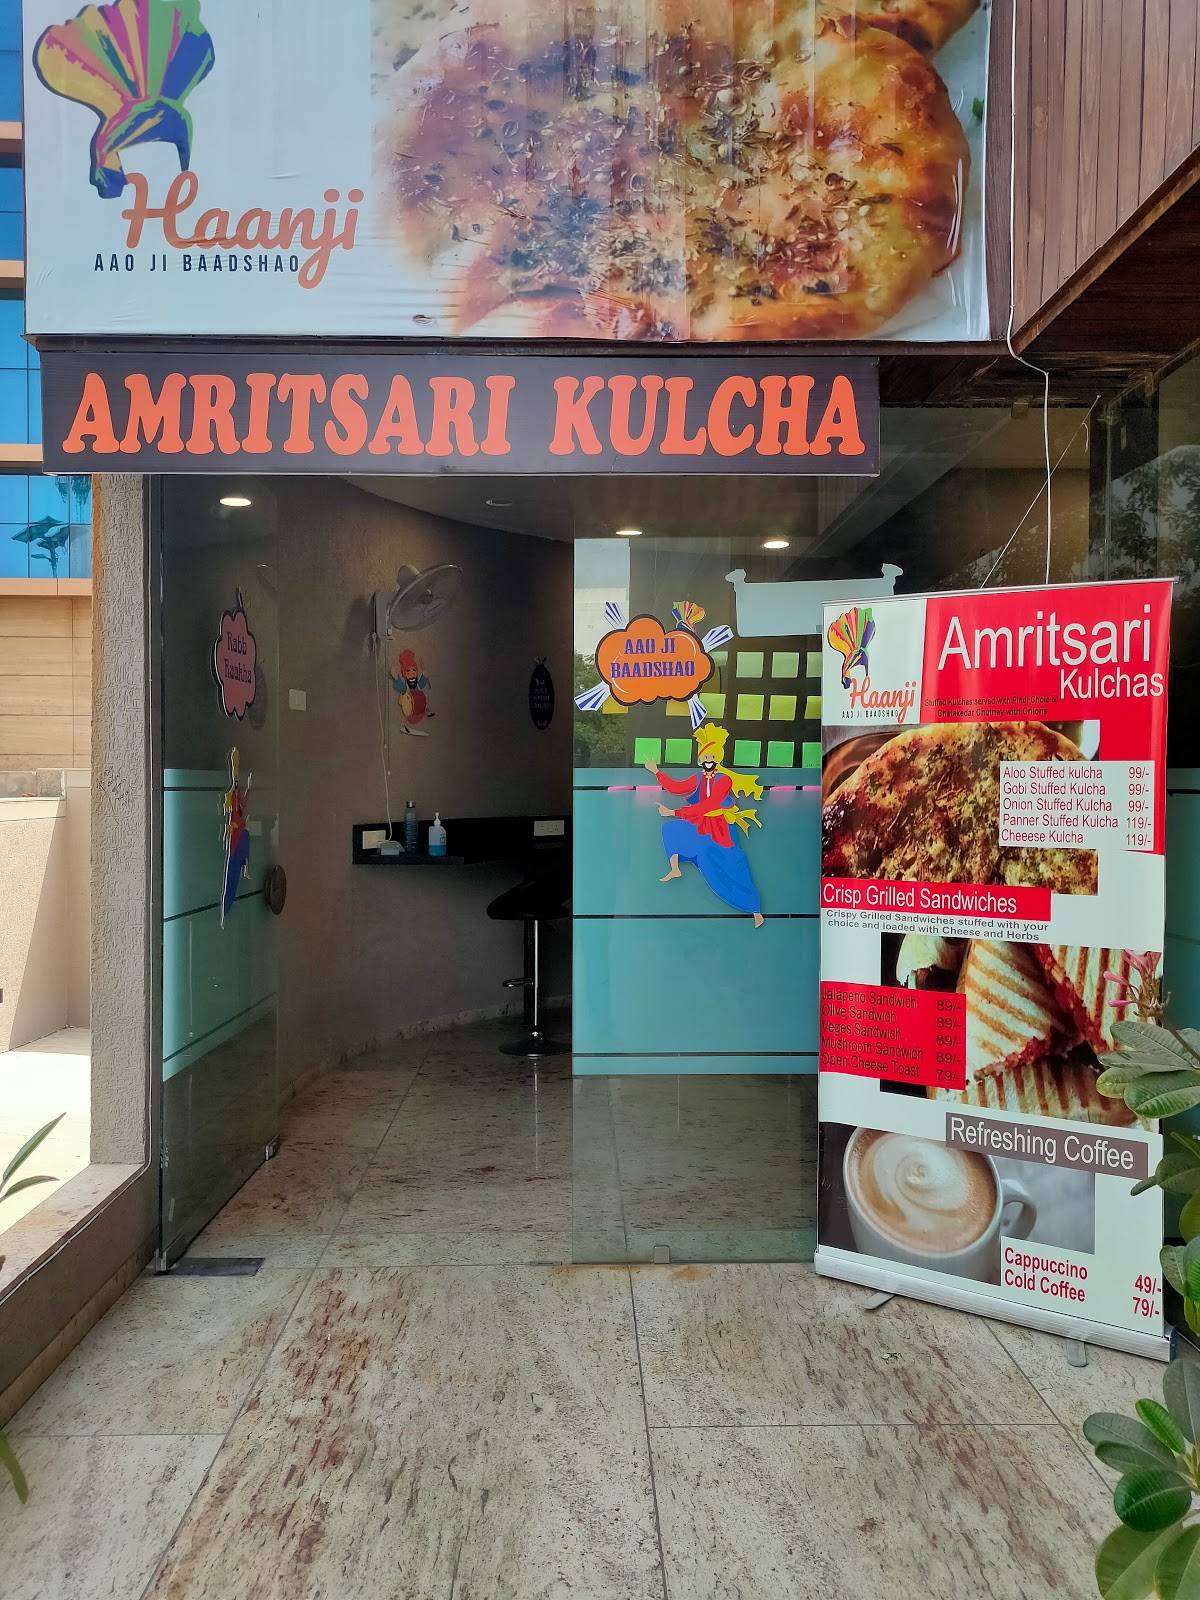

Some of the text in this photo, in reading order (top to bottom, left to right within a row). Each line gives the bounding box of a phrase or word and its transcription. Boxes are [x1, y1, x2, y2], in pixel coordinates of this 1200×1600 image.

[121, 170, 364, 288] Haanji
[94, 253, 299, 273] AAO JI BAADSHAO
[62, 373, 865, 456] AMRITSARI KULCHA
[227, 632, 247, 655] Rabb
[624, 638, 676, 654] AAO JI
[937, 604, 1151, 671] Amritsari
[611, 661, 695, 678] BAADSHAO
[1060, 667, 1164, 699] Kulchas
[850, 676, 916, 723] Haanji
[997, 697, 1009, 705] with
[842, 710, 853, 718] AAO
[865, 709, 898, 718] BAADSHAO
[1006, 707, 1020, 715] with
[1022, 707, 1048, 715] Onions
[1003, 766, 1149, 779] Aloo Stuffed kulcha 99/-
[1003, 782, 1149, 795] Gobi Stuffed Kulcha 99/-
[1003, 798, 1149, 812] Onion Stuffed Kulcha 99/-
[1003, 814, 1151, 829] Panner Stuffed Kulcha 119/-
[1001, 829, 1151, 846] Cheeese Kulcha 119/-
[823, 883, 1017, 913] Crisp Grilled Sandwiches
[826, 910, 1049, 932] Crispy Grilled Sandwiches stuffed with your
[827, 919, 1040, 941] choice and loaded with Cheese and Herbs
[869, 991, 918, 1008] Sandwich
[936, 1000, 961, 1012] 89/-
[822, 1004, 961, 1030] Olive Sandwich 89/-
[821, 1022, 961, 1047] Veges Sandwich 89/-
[821, 1036, 961, 1064] Mushroom Sandwich 89/-
[822, 1052, 961, 1081] Open Cheese Toast 79/-
[950, 1116, 1134, 1170] Refreshing Coffee
[1005, 1247, 1162, 1296] Cappuccino 49/-
[1005, 1269, 1160, 1318] Cold Coffee 79/-
